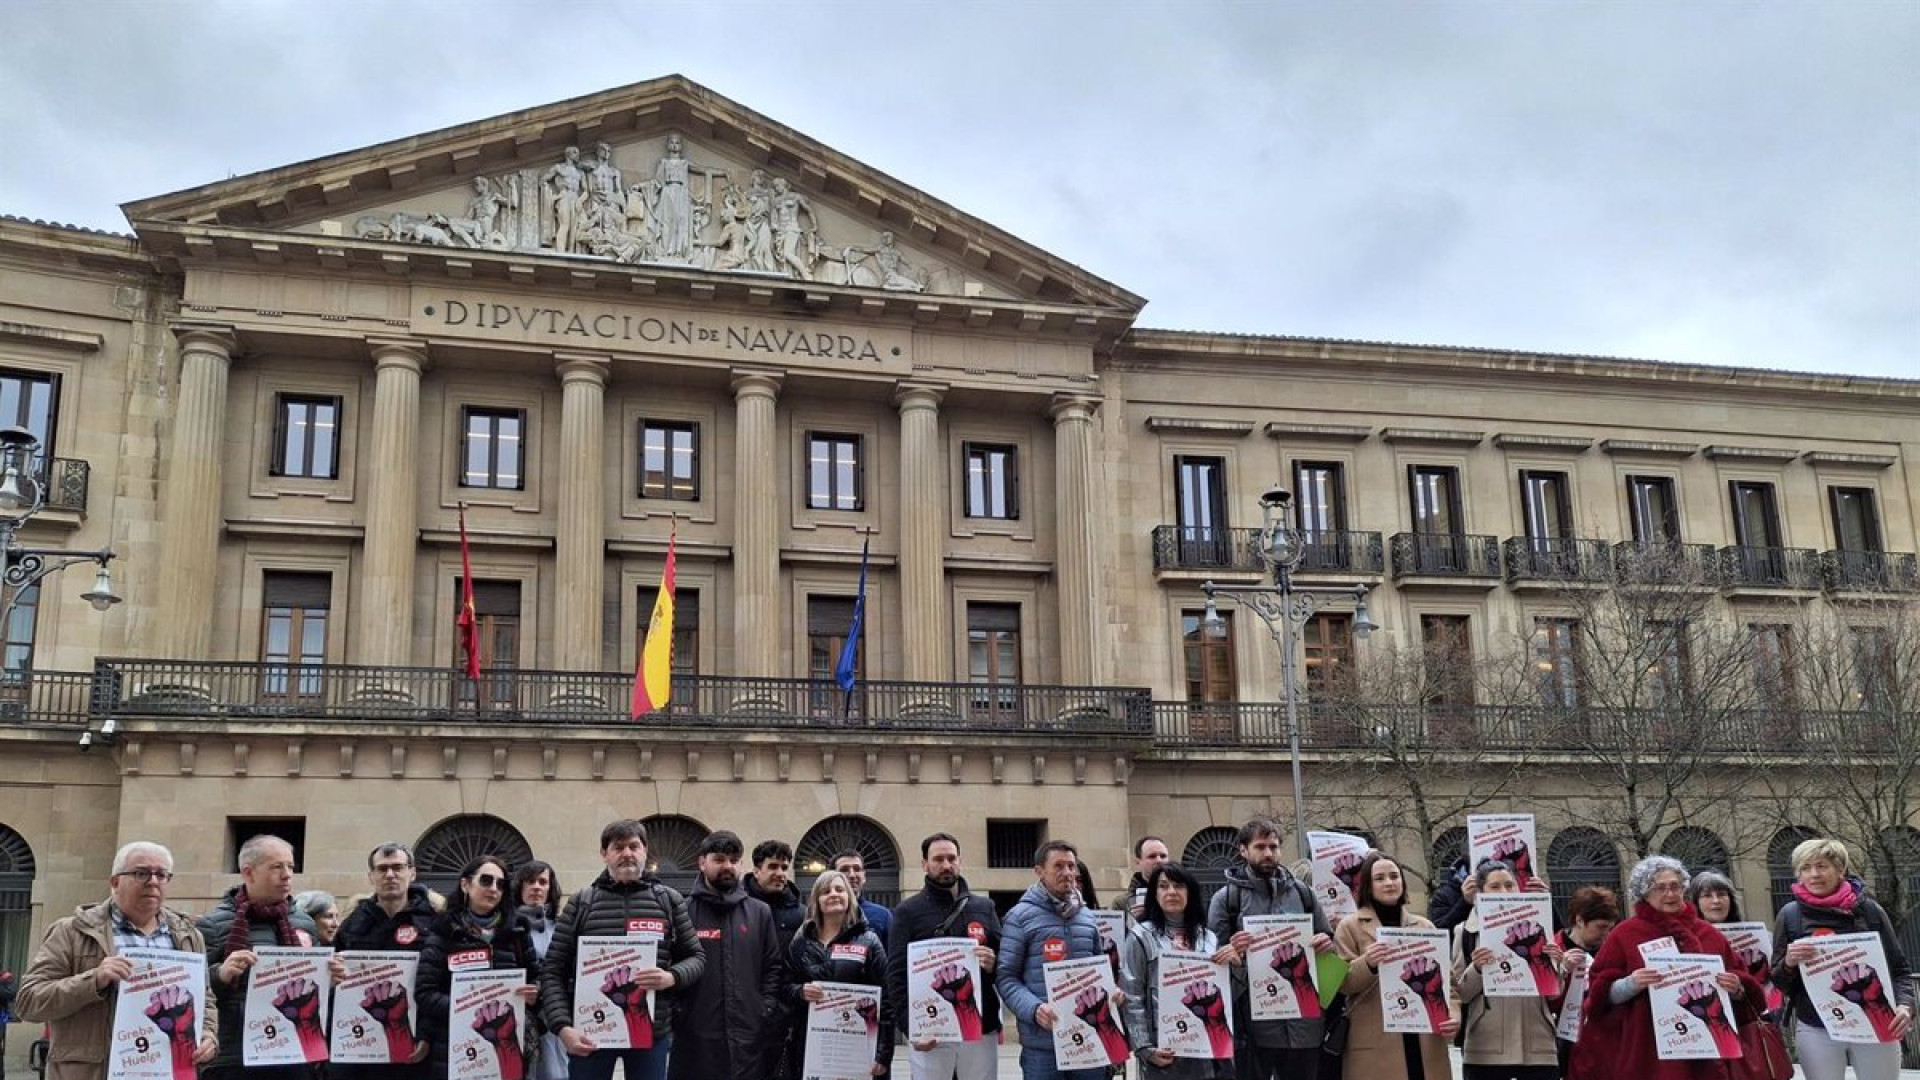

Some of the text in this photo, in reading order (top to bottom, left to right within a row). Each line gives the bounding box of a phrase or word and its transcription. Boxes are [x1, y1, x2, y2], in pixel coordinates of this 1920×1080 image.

[444, 300, 882, 362] DIPVTACION DE NAVARRA
[630, 921, 662, 931] CCOO
[834, 944, 865, 955] CCOO
[1500, 961, 1511, 973] 9
[1266, 983, 1277, 997] 9
[1397, 996, 1408, 1010] 9
[593, 1010, 605, 1023] 9
[842, 1011, 850, 1021] 9
[926, 1005, 937, 1018] 9
[1832, 1007, 1844, 1020] 9
[250, 1016, 281, 1030] Greba
[1176, 1020, 1188, 1033] 9
[1675, 1022, 1688, 1035] 9
[118, 1026, 154, 1041] Greba
[264, 1025, 277, 1039] 9
[352, 1025, 364, 1039] 9
[1072, 1032, 1083, 1046] 9
[135, 1036, 149, 1053] 9
[121, 1051, 161, 1068] Huelga
[466, 1047, 477, 1061] 9
